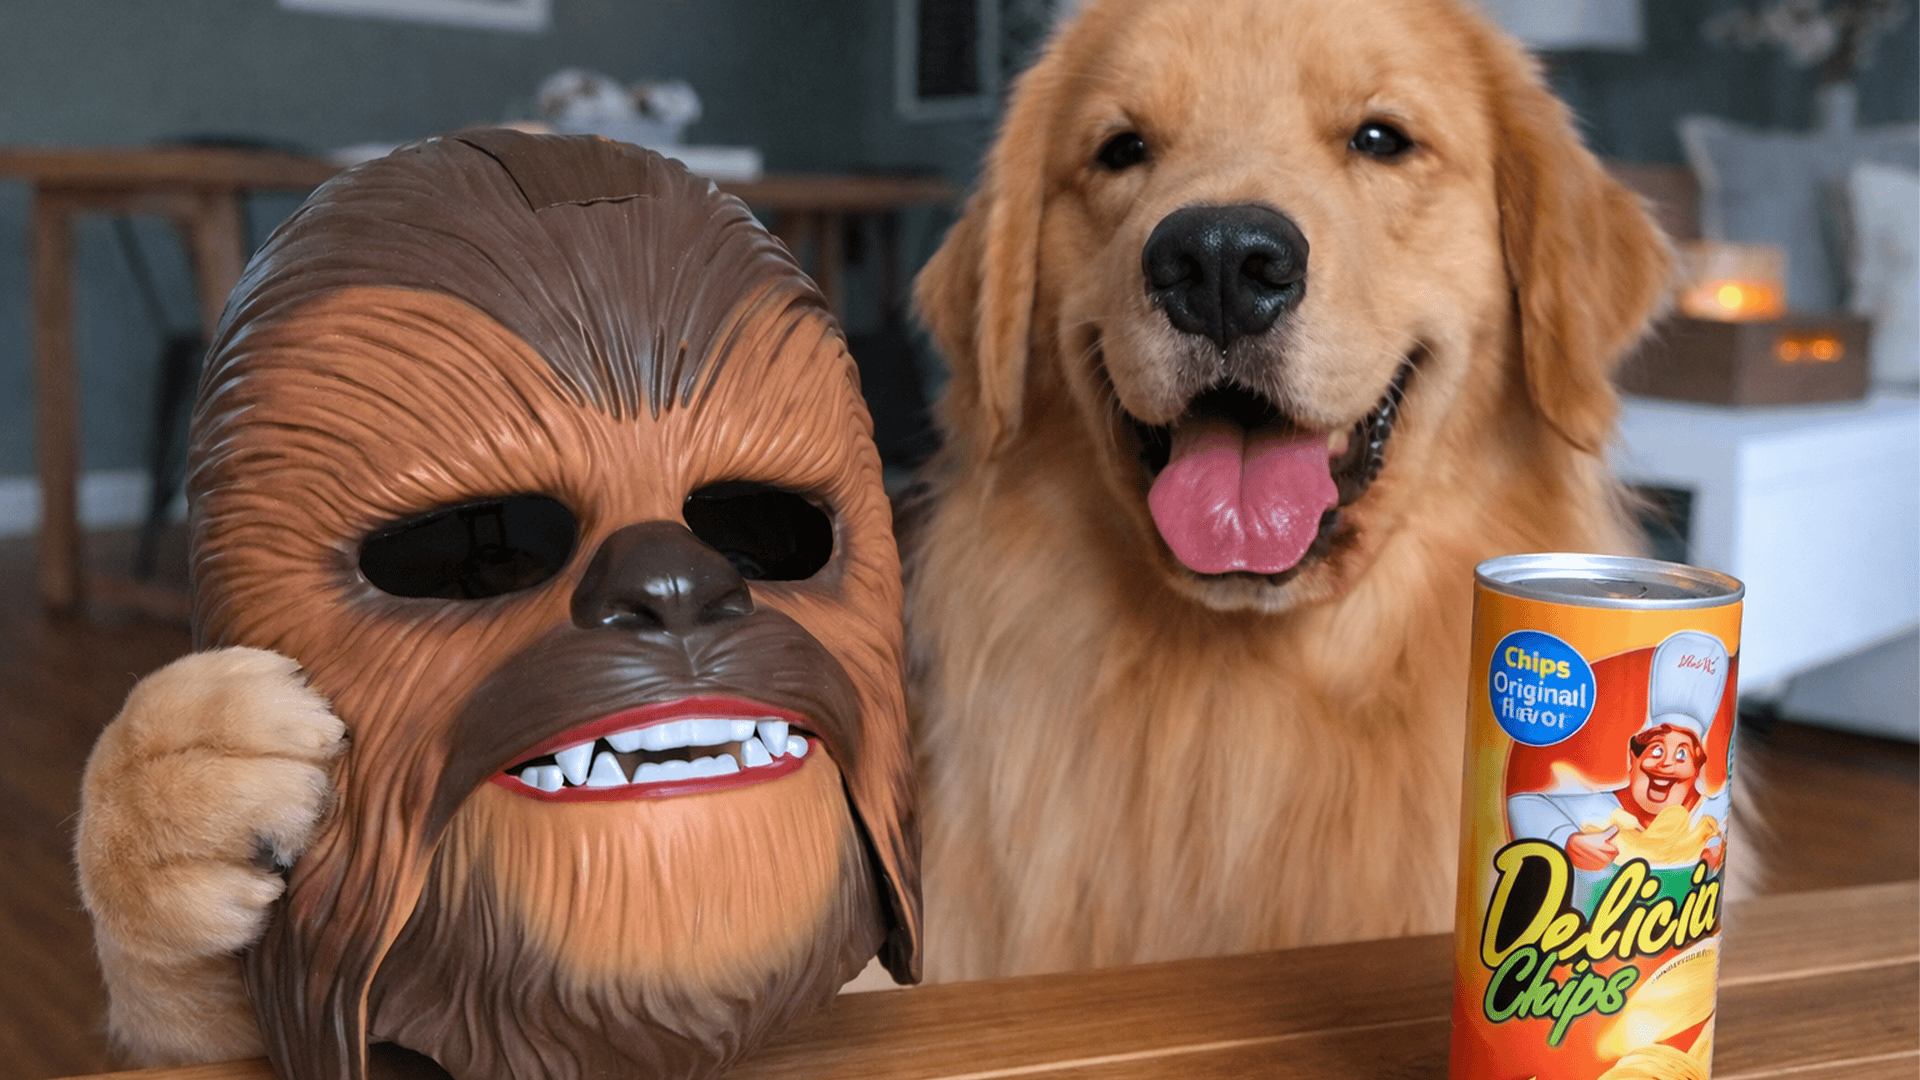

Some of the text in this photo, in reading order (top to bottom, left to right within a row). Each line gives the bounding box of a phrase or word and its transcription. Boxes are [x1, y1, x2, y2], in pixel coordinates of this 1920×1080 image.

[1494, 671, 1586, 709] Original
[1505, 646, 1571, 679] Chips
[1481, 839, 1720, 969] Delicia
[1484, 945, 1640, 1047] Chips
